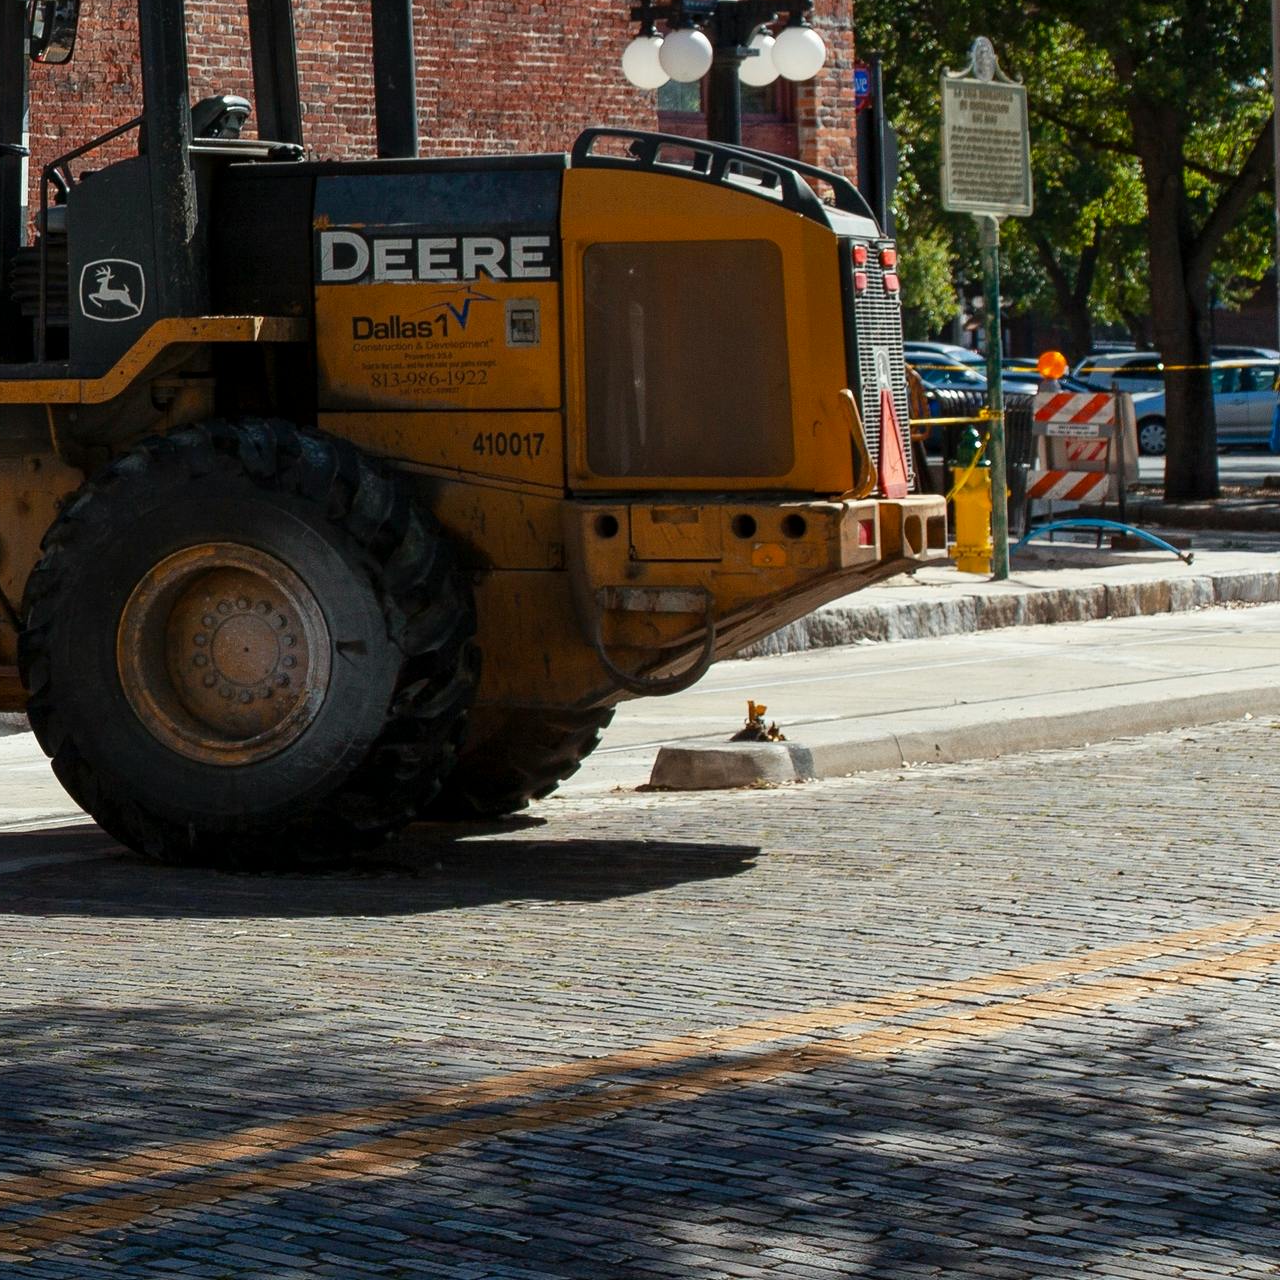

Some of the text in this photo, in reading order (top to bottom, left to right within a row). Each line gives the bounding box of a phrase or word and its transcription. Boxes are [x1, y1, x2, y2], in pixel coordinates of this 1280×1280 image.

[320, 231, 551, 281] DEERE
[352, 342, 413, 353] Construction
[426, 340, 489, 351] Development
[370, 369, 488, 388] 813-986-1922
[473, 431, 545, 457] 410017
